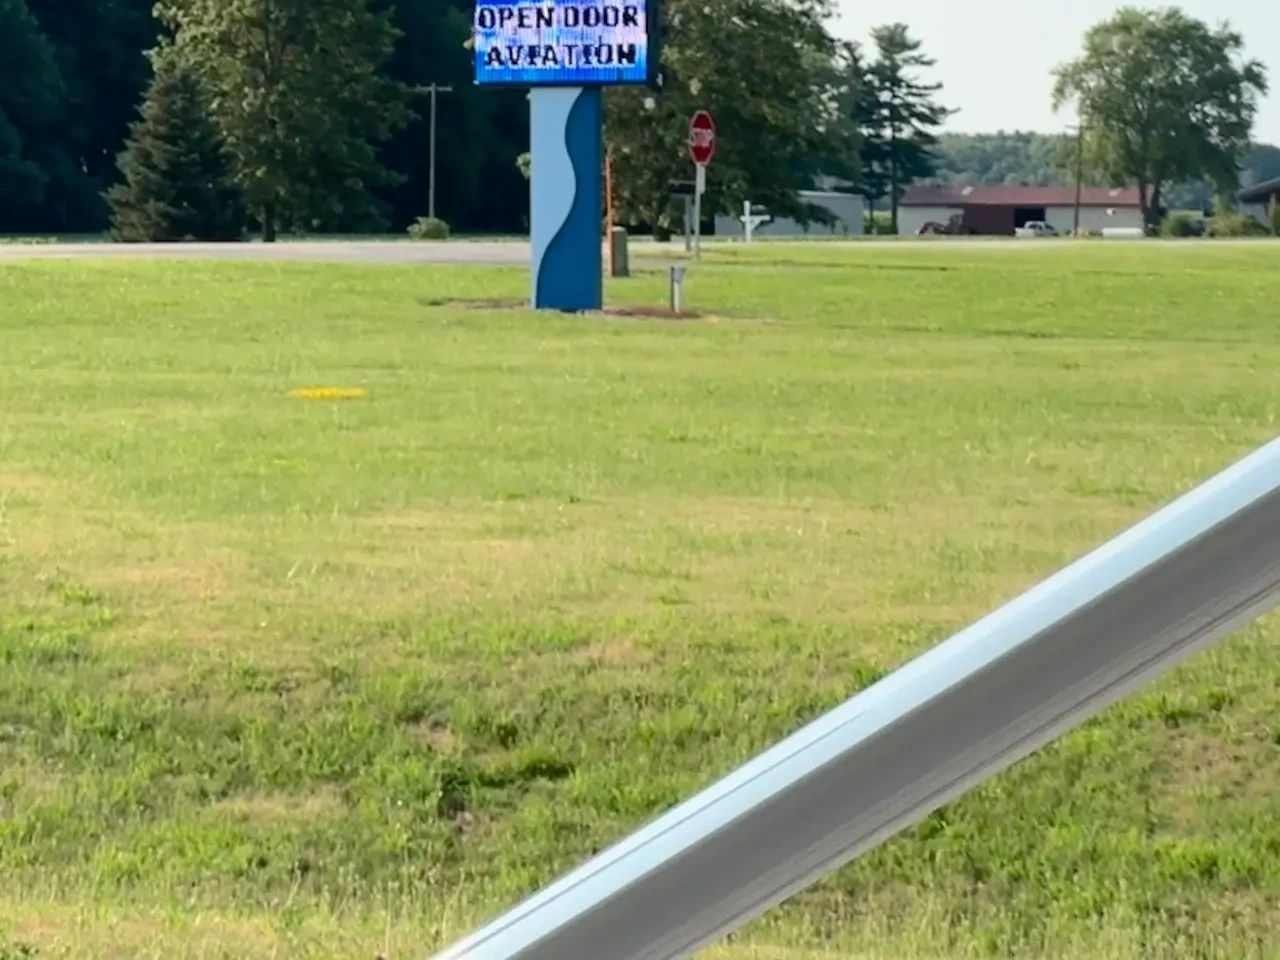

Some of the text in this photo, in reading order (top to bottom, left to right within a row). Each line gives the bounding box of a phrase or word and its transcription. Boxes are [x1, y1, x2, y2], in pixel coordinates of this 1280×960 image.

[478, 6, 639, 29] OPEN DOOR
[487, 43, 636, 66] AVIATION
